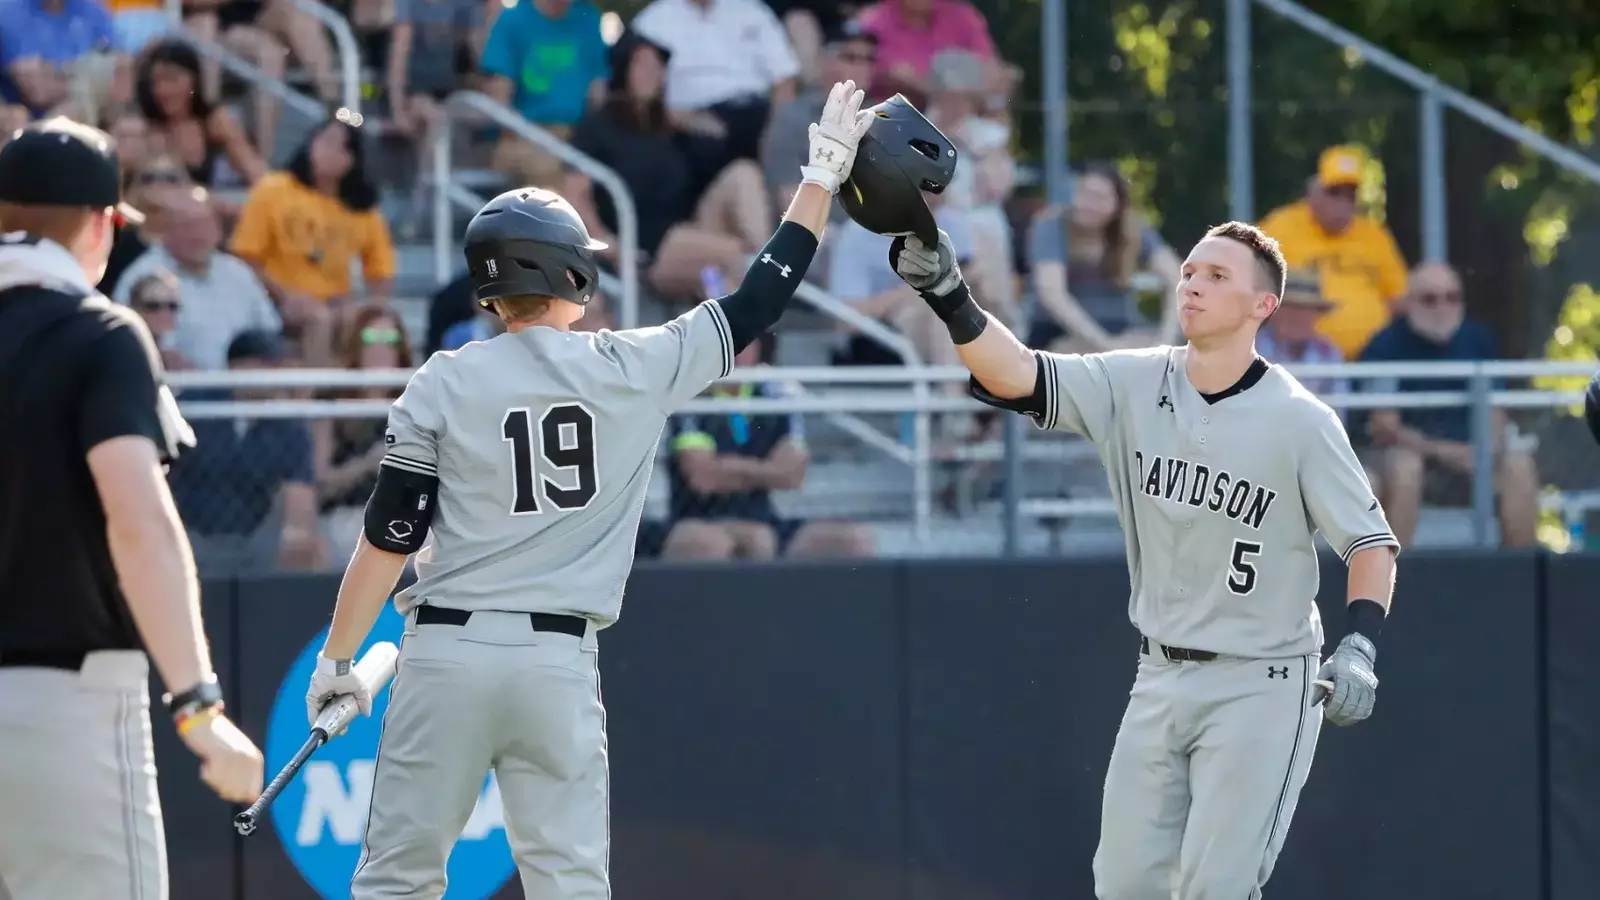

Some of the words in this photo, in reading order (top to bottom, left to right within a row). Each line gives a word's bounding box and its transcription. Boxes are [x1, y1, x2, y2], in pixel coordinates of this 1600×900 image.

[486, 258, 497, 272] 19
[501, 401, 600, 516] 19
[1226, 538, 1263, 596] 5
